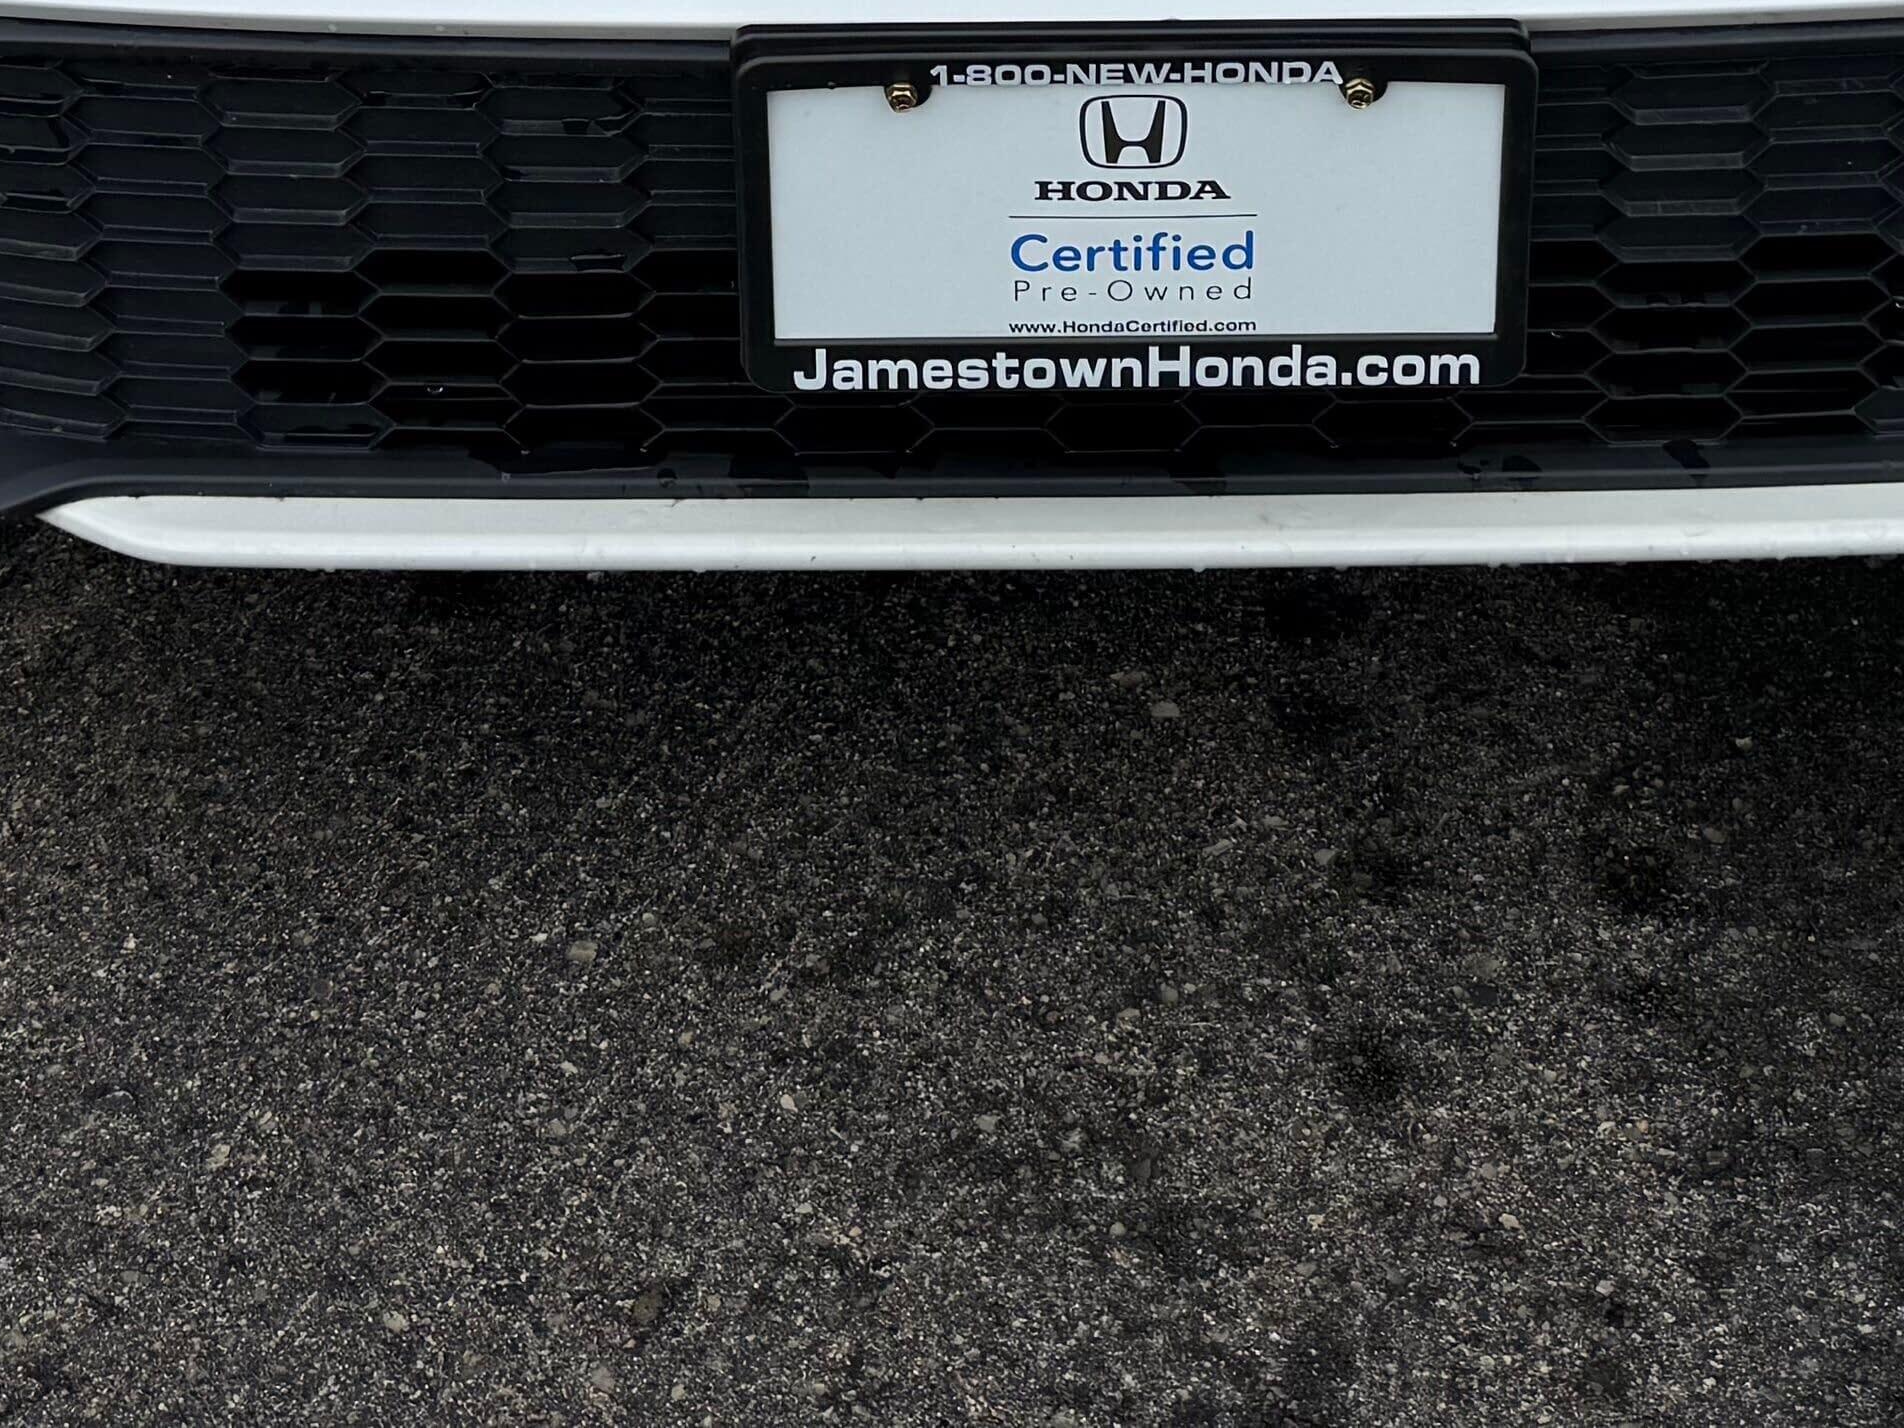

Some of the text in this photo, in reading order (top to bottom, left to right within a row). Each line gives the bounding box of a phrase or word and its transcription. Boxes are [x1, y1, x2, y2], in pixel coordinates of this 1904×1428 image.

[930, 61, 1342, 86] 1-800-NEW-HONDA
[1034, 180, 1231, 201] HONDA
[1010, 231, 1255, 272] Certified
[1014, 278, 1252, 302] Pre-Owned
[1009, 319, 1257, 334] www.HondaCertified.com
[793, 345, 1481, 390] JamestownHonda.com
